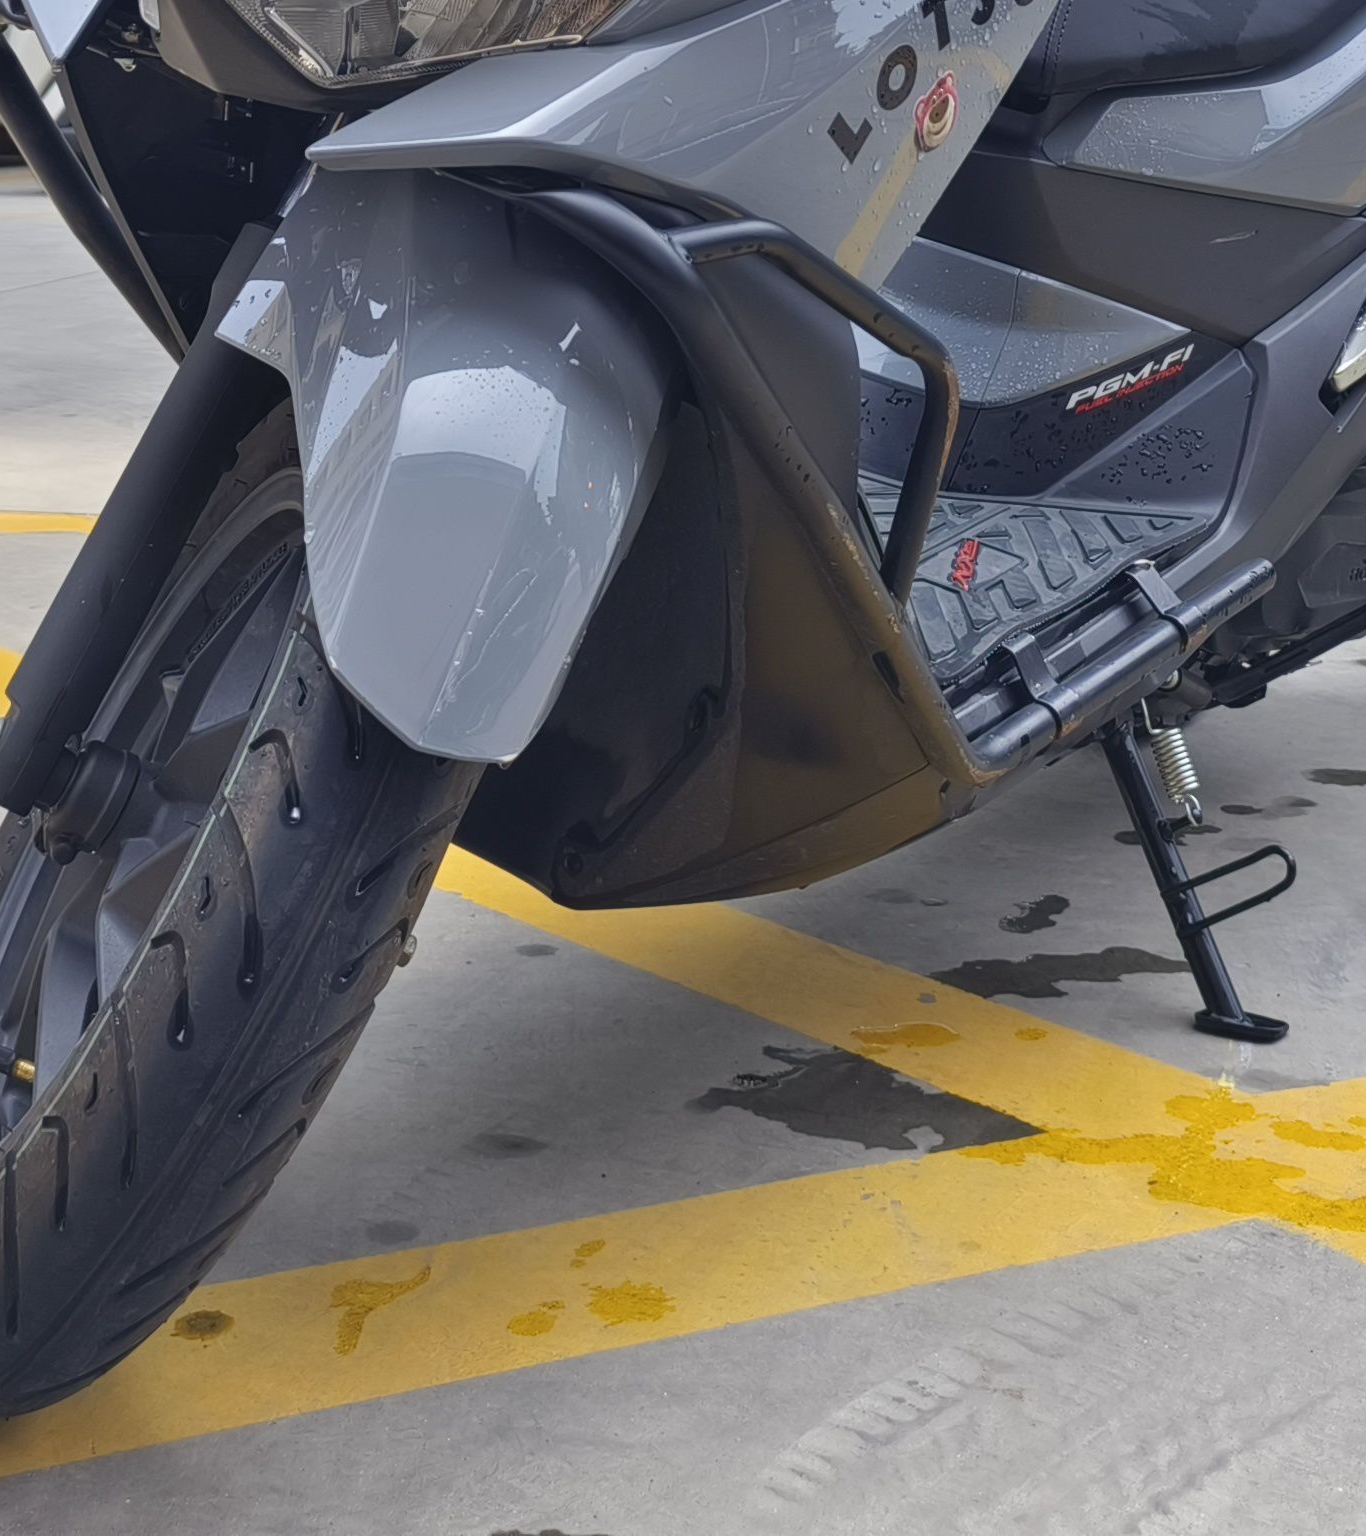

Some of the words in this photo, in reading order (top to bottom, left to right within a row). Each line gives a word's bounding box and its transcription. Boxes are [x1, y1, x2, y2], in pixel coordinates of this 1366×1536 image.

[1065, 343, 1195, 410] PGM-FI
[1075, 395, 1114, 415] FUEL
[1116, 364, 1184, 399] INJECTION
